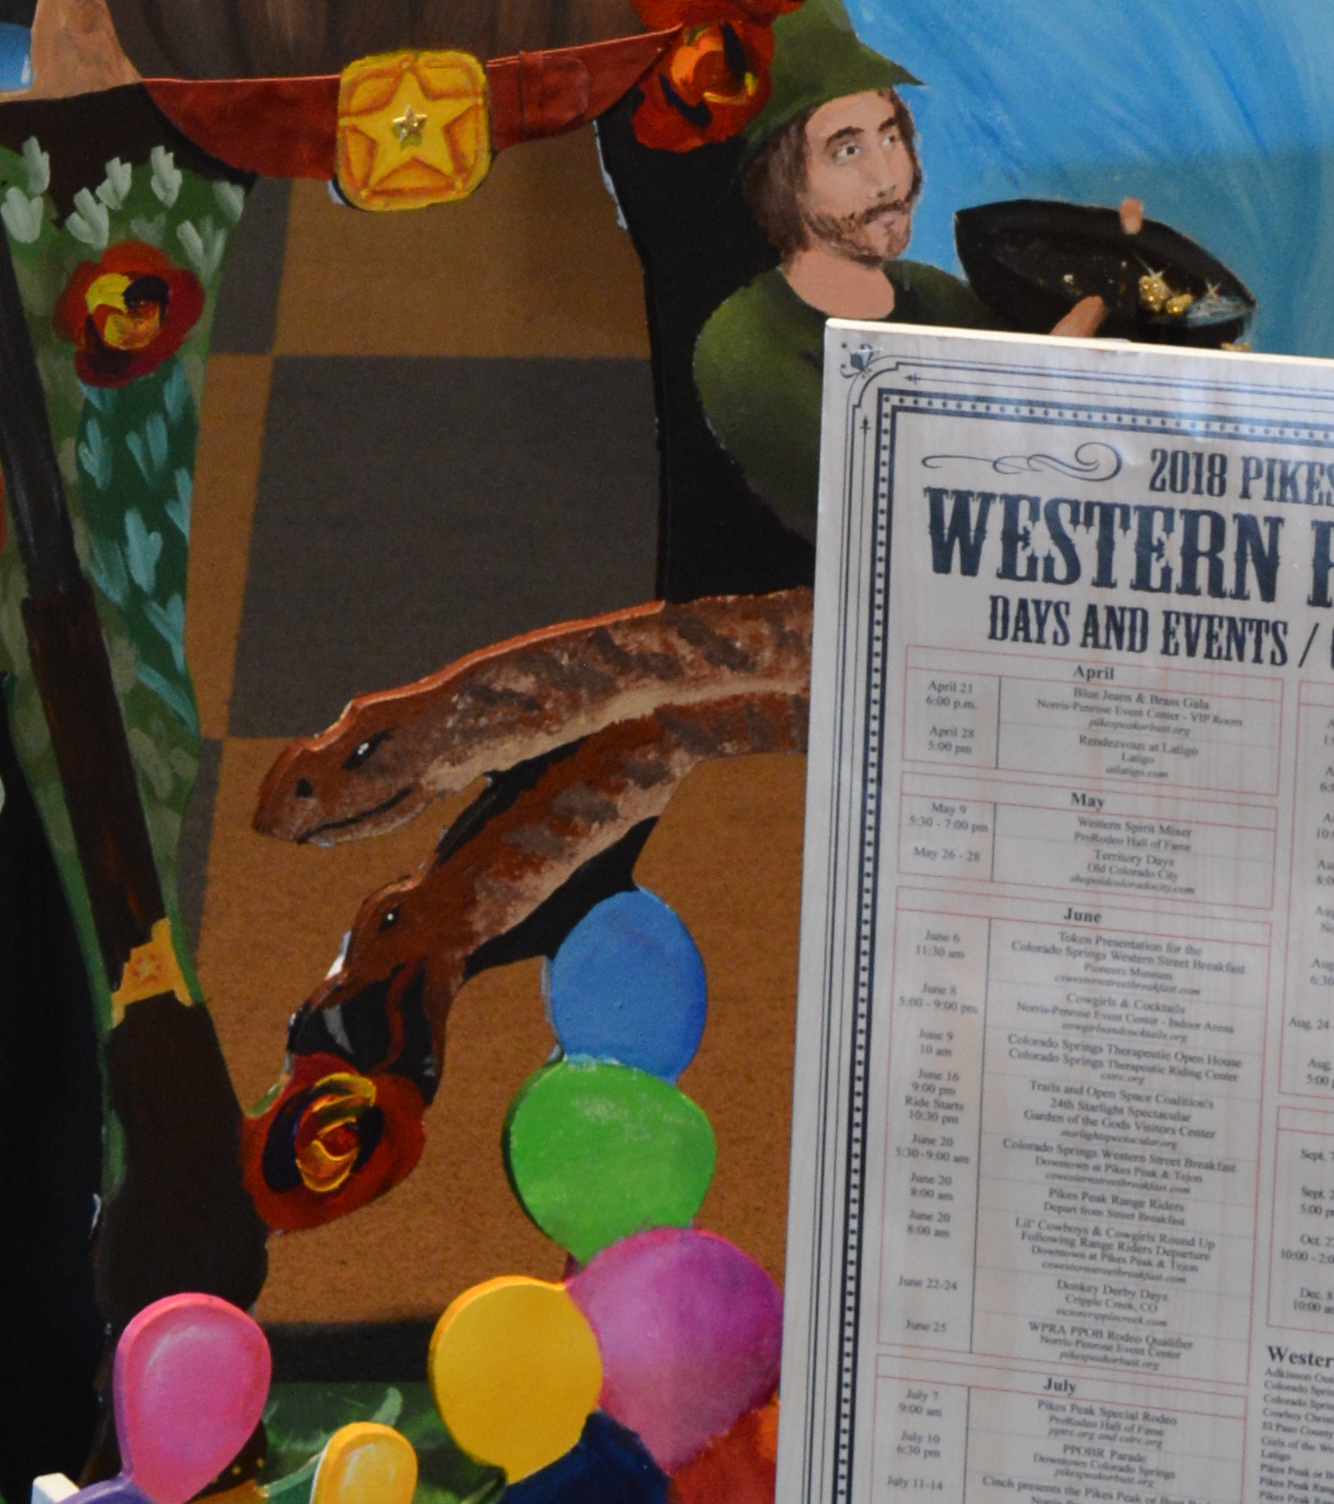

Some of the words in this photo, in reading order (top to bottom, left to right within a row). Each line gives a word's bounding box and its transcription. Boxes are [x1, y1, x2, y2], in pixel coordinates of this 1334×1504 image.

[1148, 448, 1228, 498] 2018
[922, 486, 1285, 604] WESTERN
[987, 594, 1071, 647] DAYS
[1079, 603, 1150, 654] AND
[1160, 609, 1289, 667] EVENTS
[1297, 622, 1320, 668] /
[1073, 664, 1115, 683] April
[927, 680, 957, 694] April
[959, 682, 973, 694] 21
[1071, 792, 1104, 812] May
[913, 845, 939, 861] May
[941, 848, 956, 860] 26
[966, 850, 981, 863] 28
[1063, 907, 1102, 924] June
[924, 929, 950, 943] June
[952, 933, 961, 943] 6
[1010, 940, 1063, 956] Colorado
[1065, 945, 1107, 963] Springs
[1110, 950, 1155, 965] Western
[1156, 955, 1190, 969] Street
[1192, 958, 1246, 975] Breakfast
[1043, 1377, 1076, 1396] July
[886, 1475, 909, 1490] July
[913, 1478, 944, 1491] 11-14
